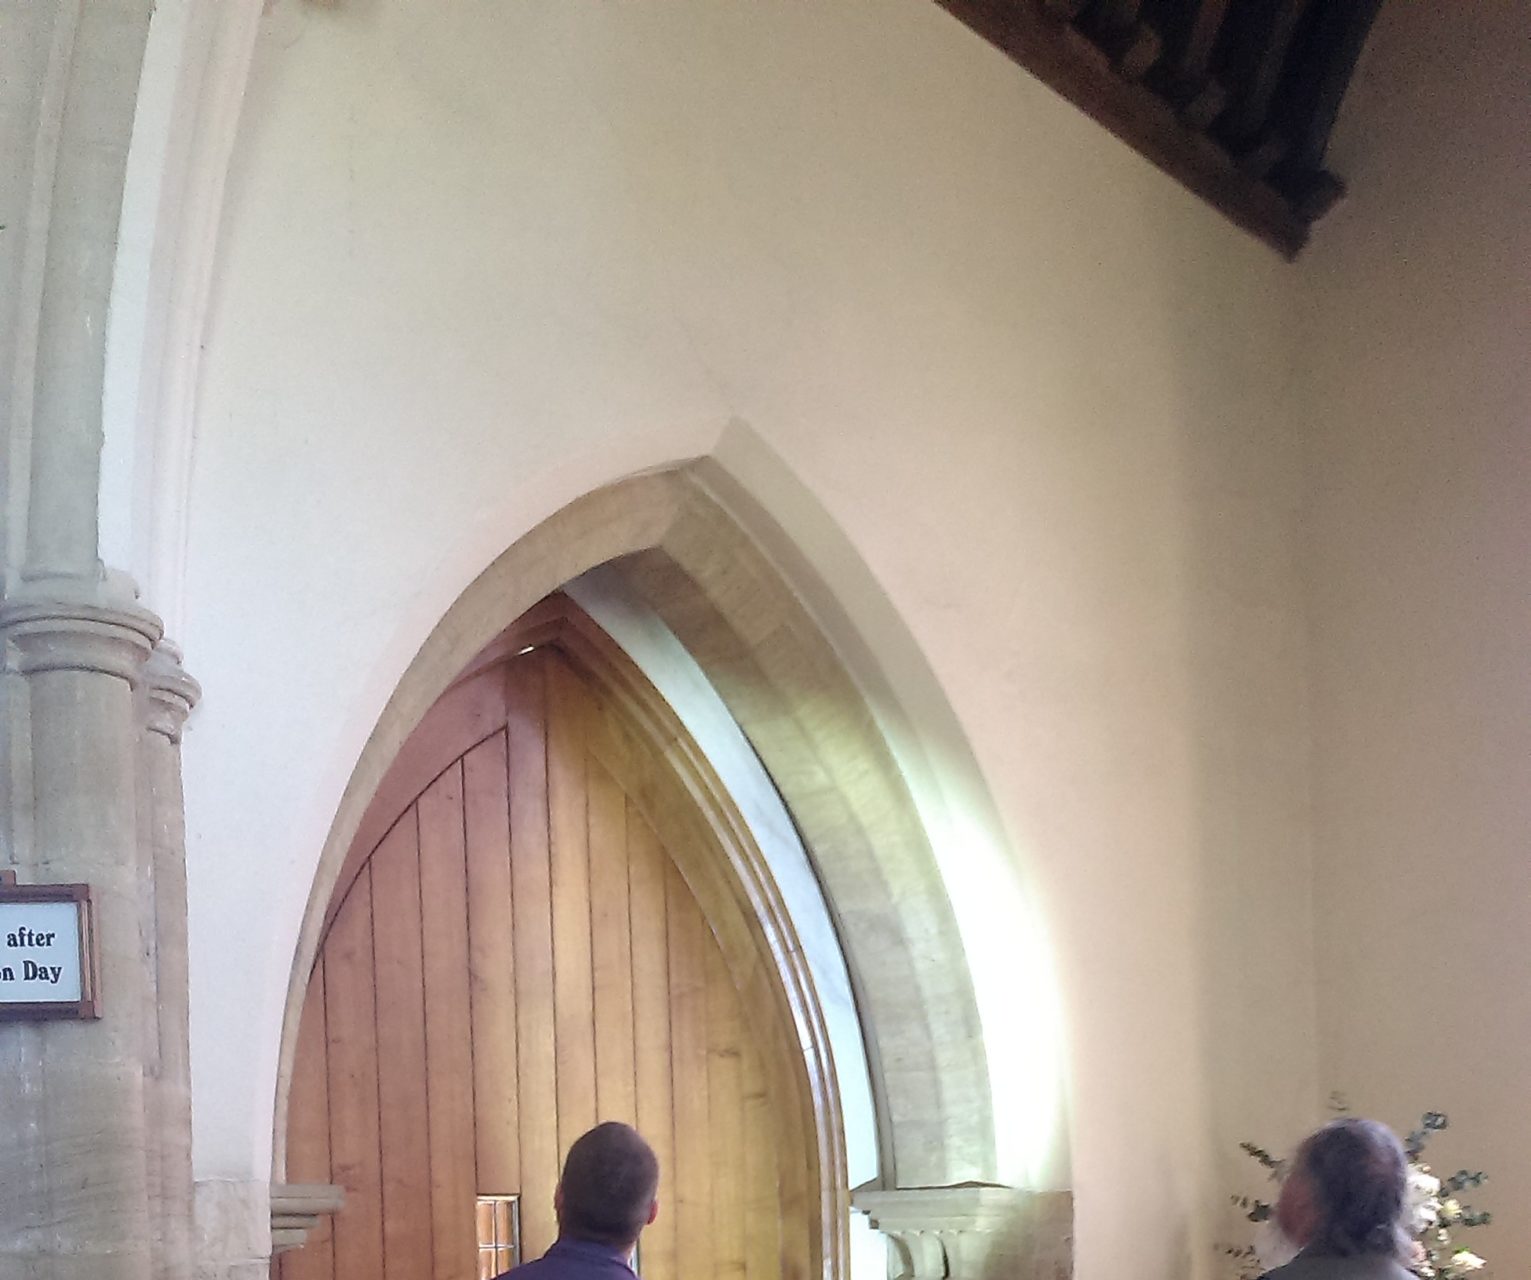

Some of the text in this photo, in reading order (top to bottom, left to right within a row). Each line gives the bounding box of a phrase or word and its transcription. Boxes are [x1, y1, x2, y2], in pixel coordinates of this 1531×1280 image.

[7, 926, 55, 947] after
[0, 960, 62, 984] n Day
